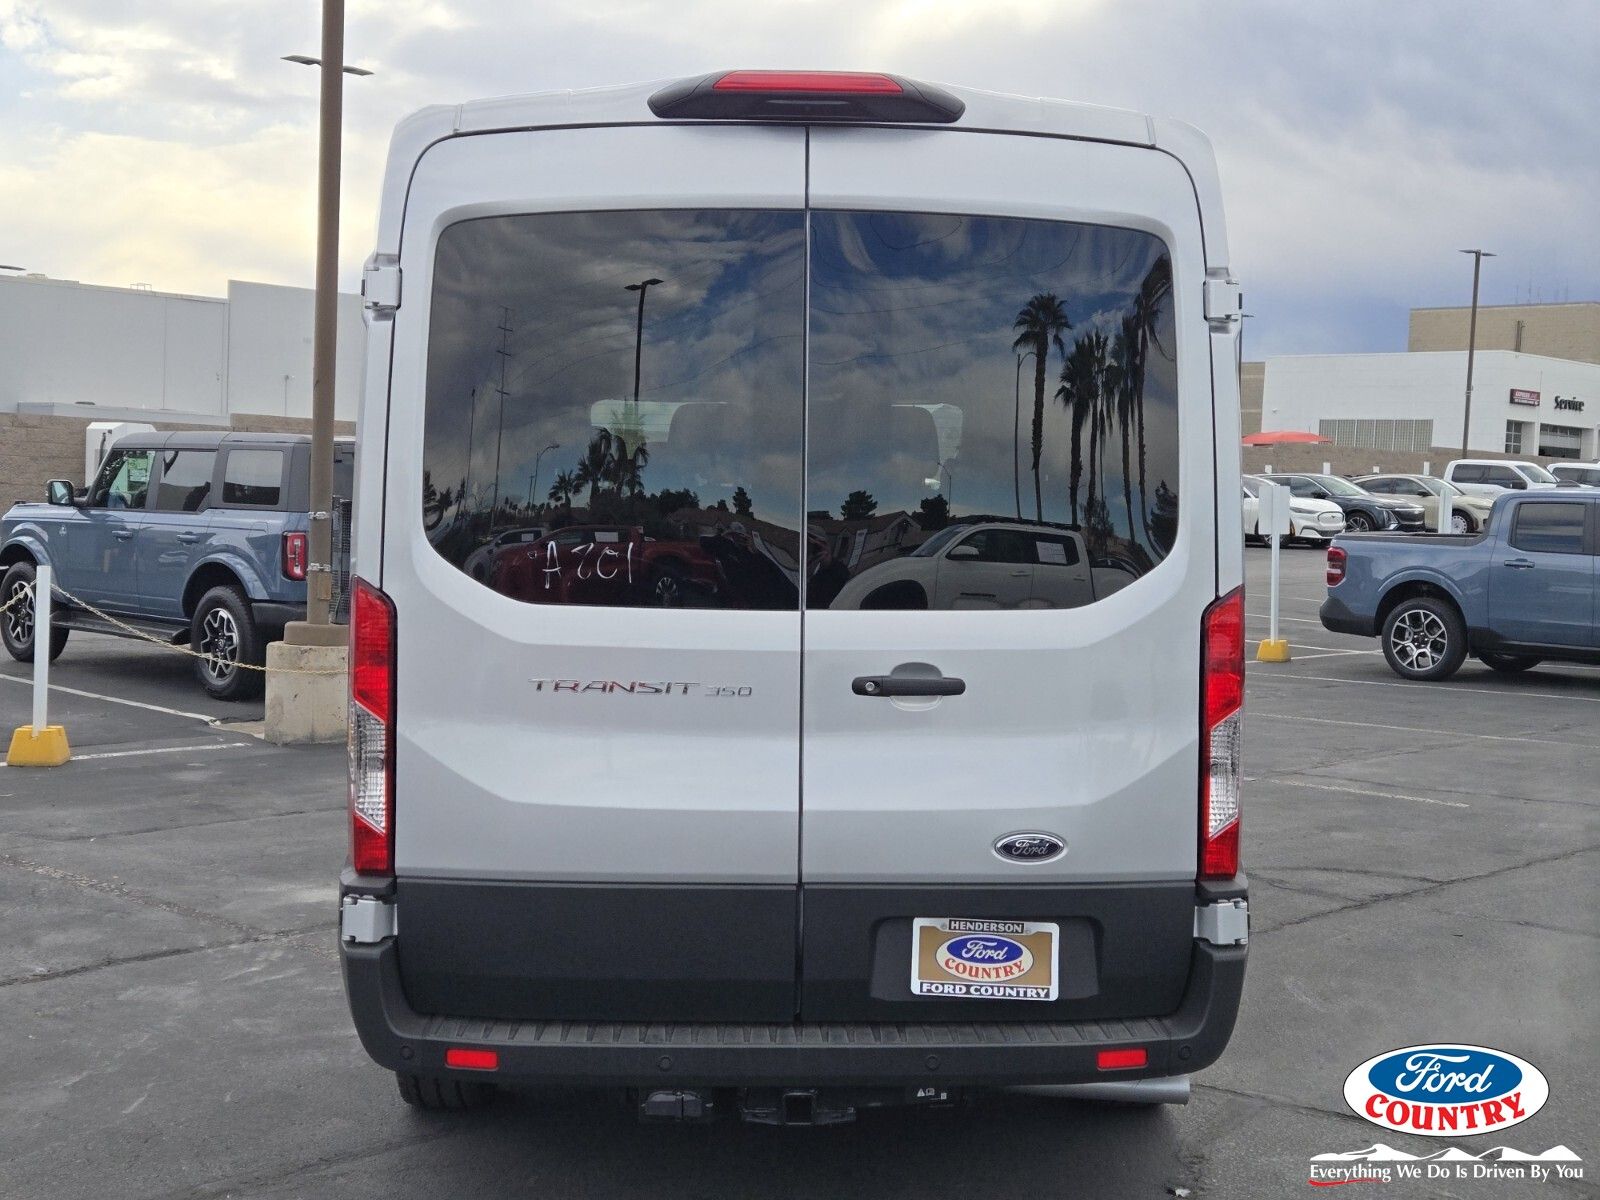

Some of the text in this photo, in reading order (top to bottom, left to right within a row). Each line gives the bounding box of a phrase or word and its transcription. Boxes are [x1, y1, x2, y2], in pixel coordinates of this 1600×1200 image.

[1554, 395, 1585, 412] Service
[528, 678, 753, 698] TRANSIT 350
[1011, 839, 1050, 855] Ford
[950, 920, 1023, 933] HENDERSON
[961, 939, 1009, 961] Ford
[944, 957, 1025, 979] COUNTRY
[922, 982, 1049, 998] FORD COUNTRY
